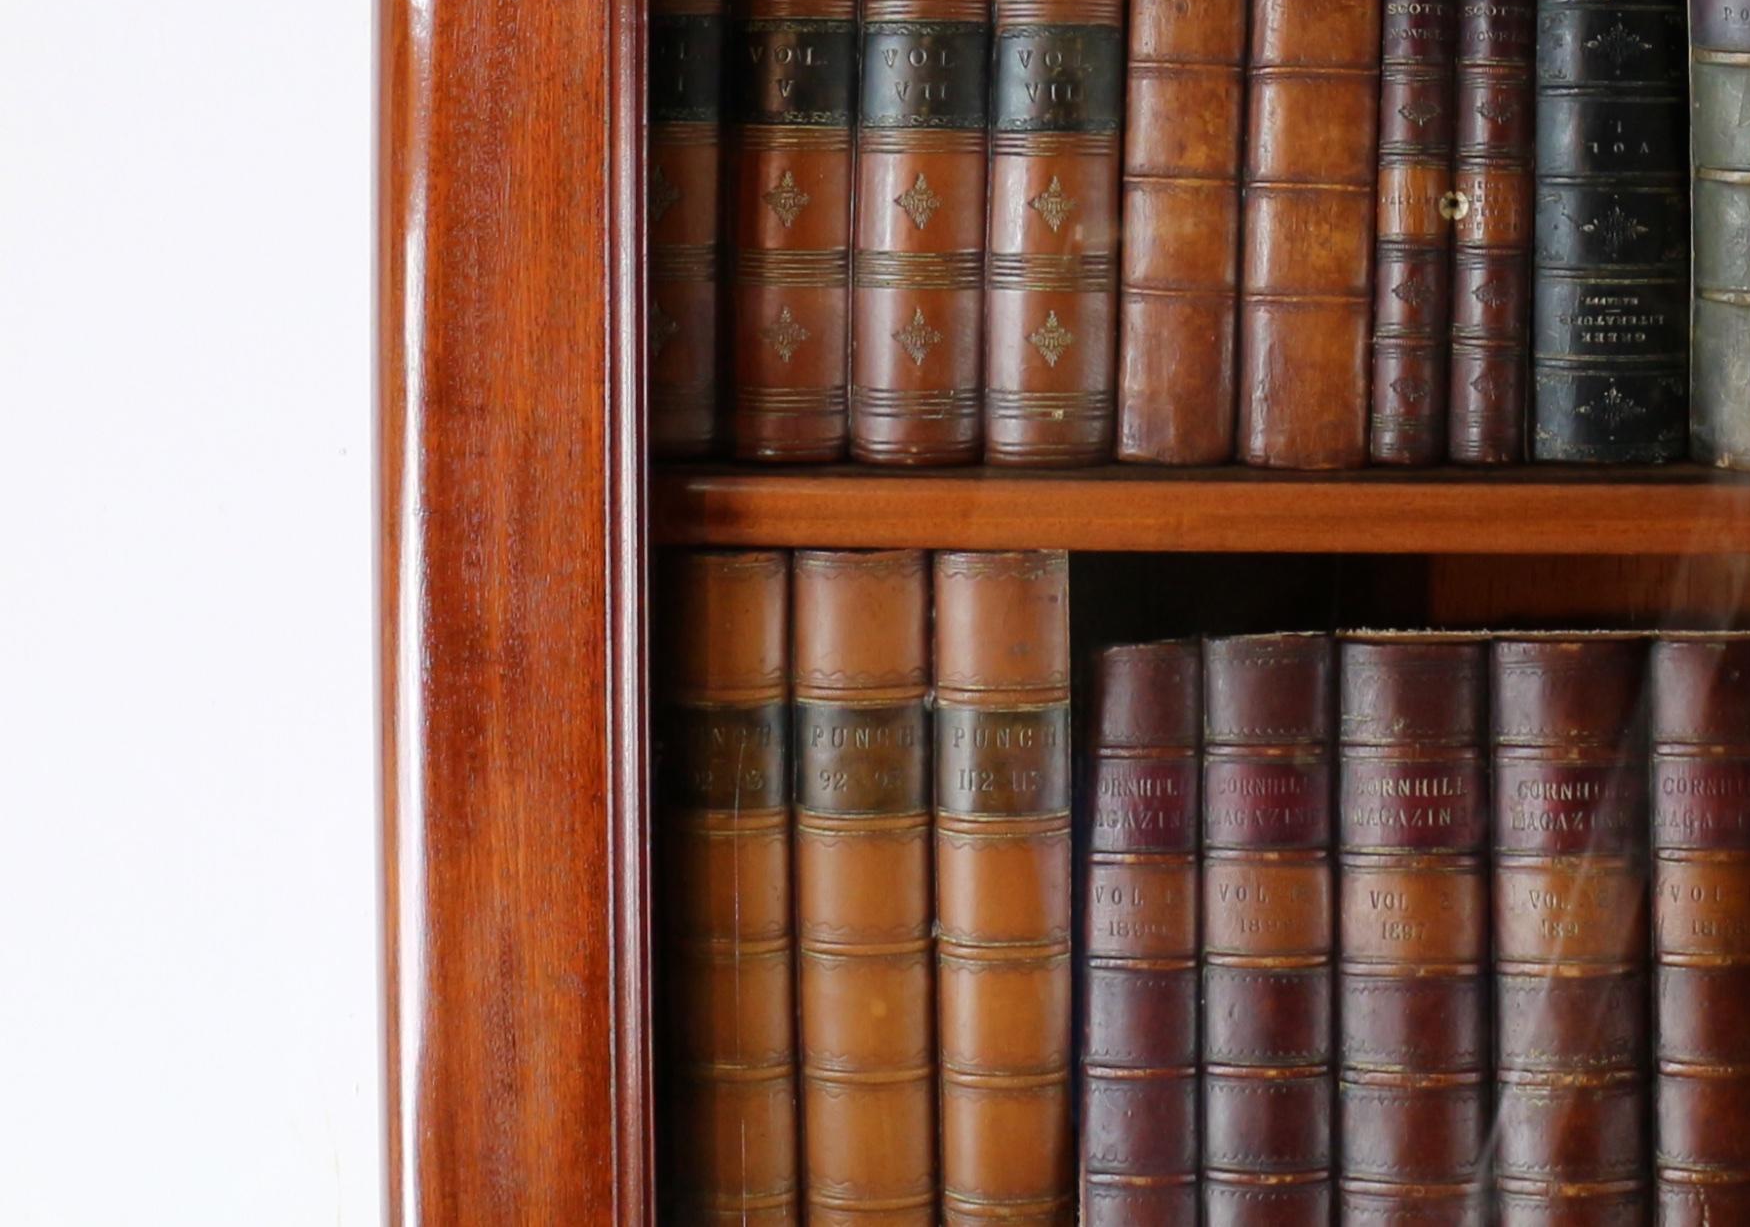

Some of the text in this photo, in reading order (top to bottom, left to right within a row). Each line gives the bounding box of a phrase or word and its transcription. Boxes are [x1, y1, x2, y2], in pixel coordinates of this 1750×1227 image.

[882, 47, 956, 68] VOL
[1586, 141, 1649, 155] VOL
[1581, 332, 1646, 344] GREEK
[810, 724, 914, 750] PUNCH
[952, 725, 1057, 750] PUNCH
[1356, 775, 1468, 798] CORNHILL
[1352, 806, 1468, 828] MAGAZINE
[1094, 884, 1144, 906] VOL
[1218, 883, 1270, 905] VOL
[1369, 889, 1409, 911] VOL
[1381, 921, 1427, 943] 1897
